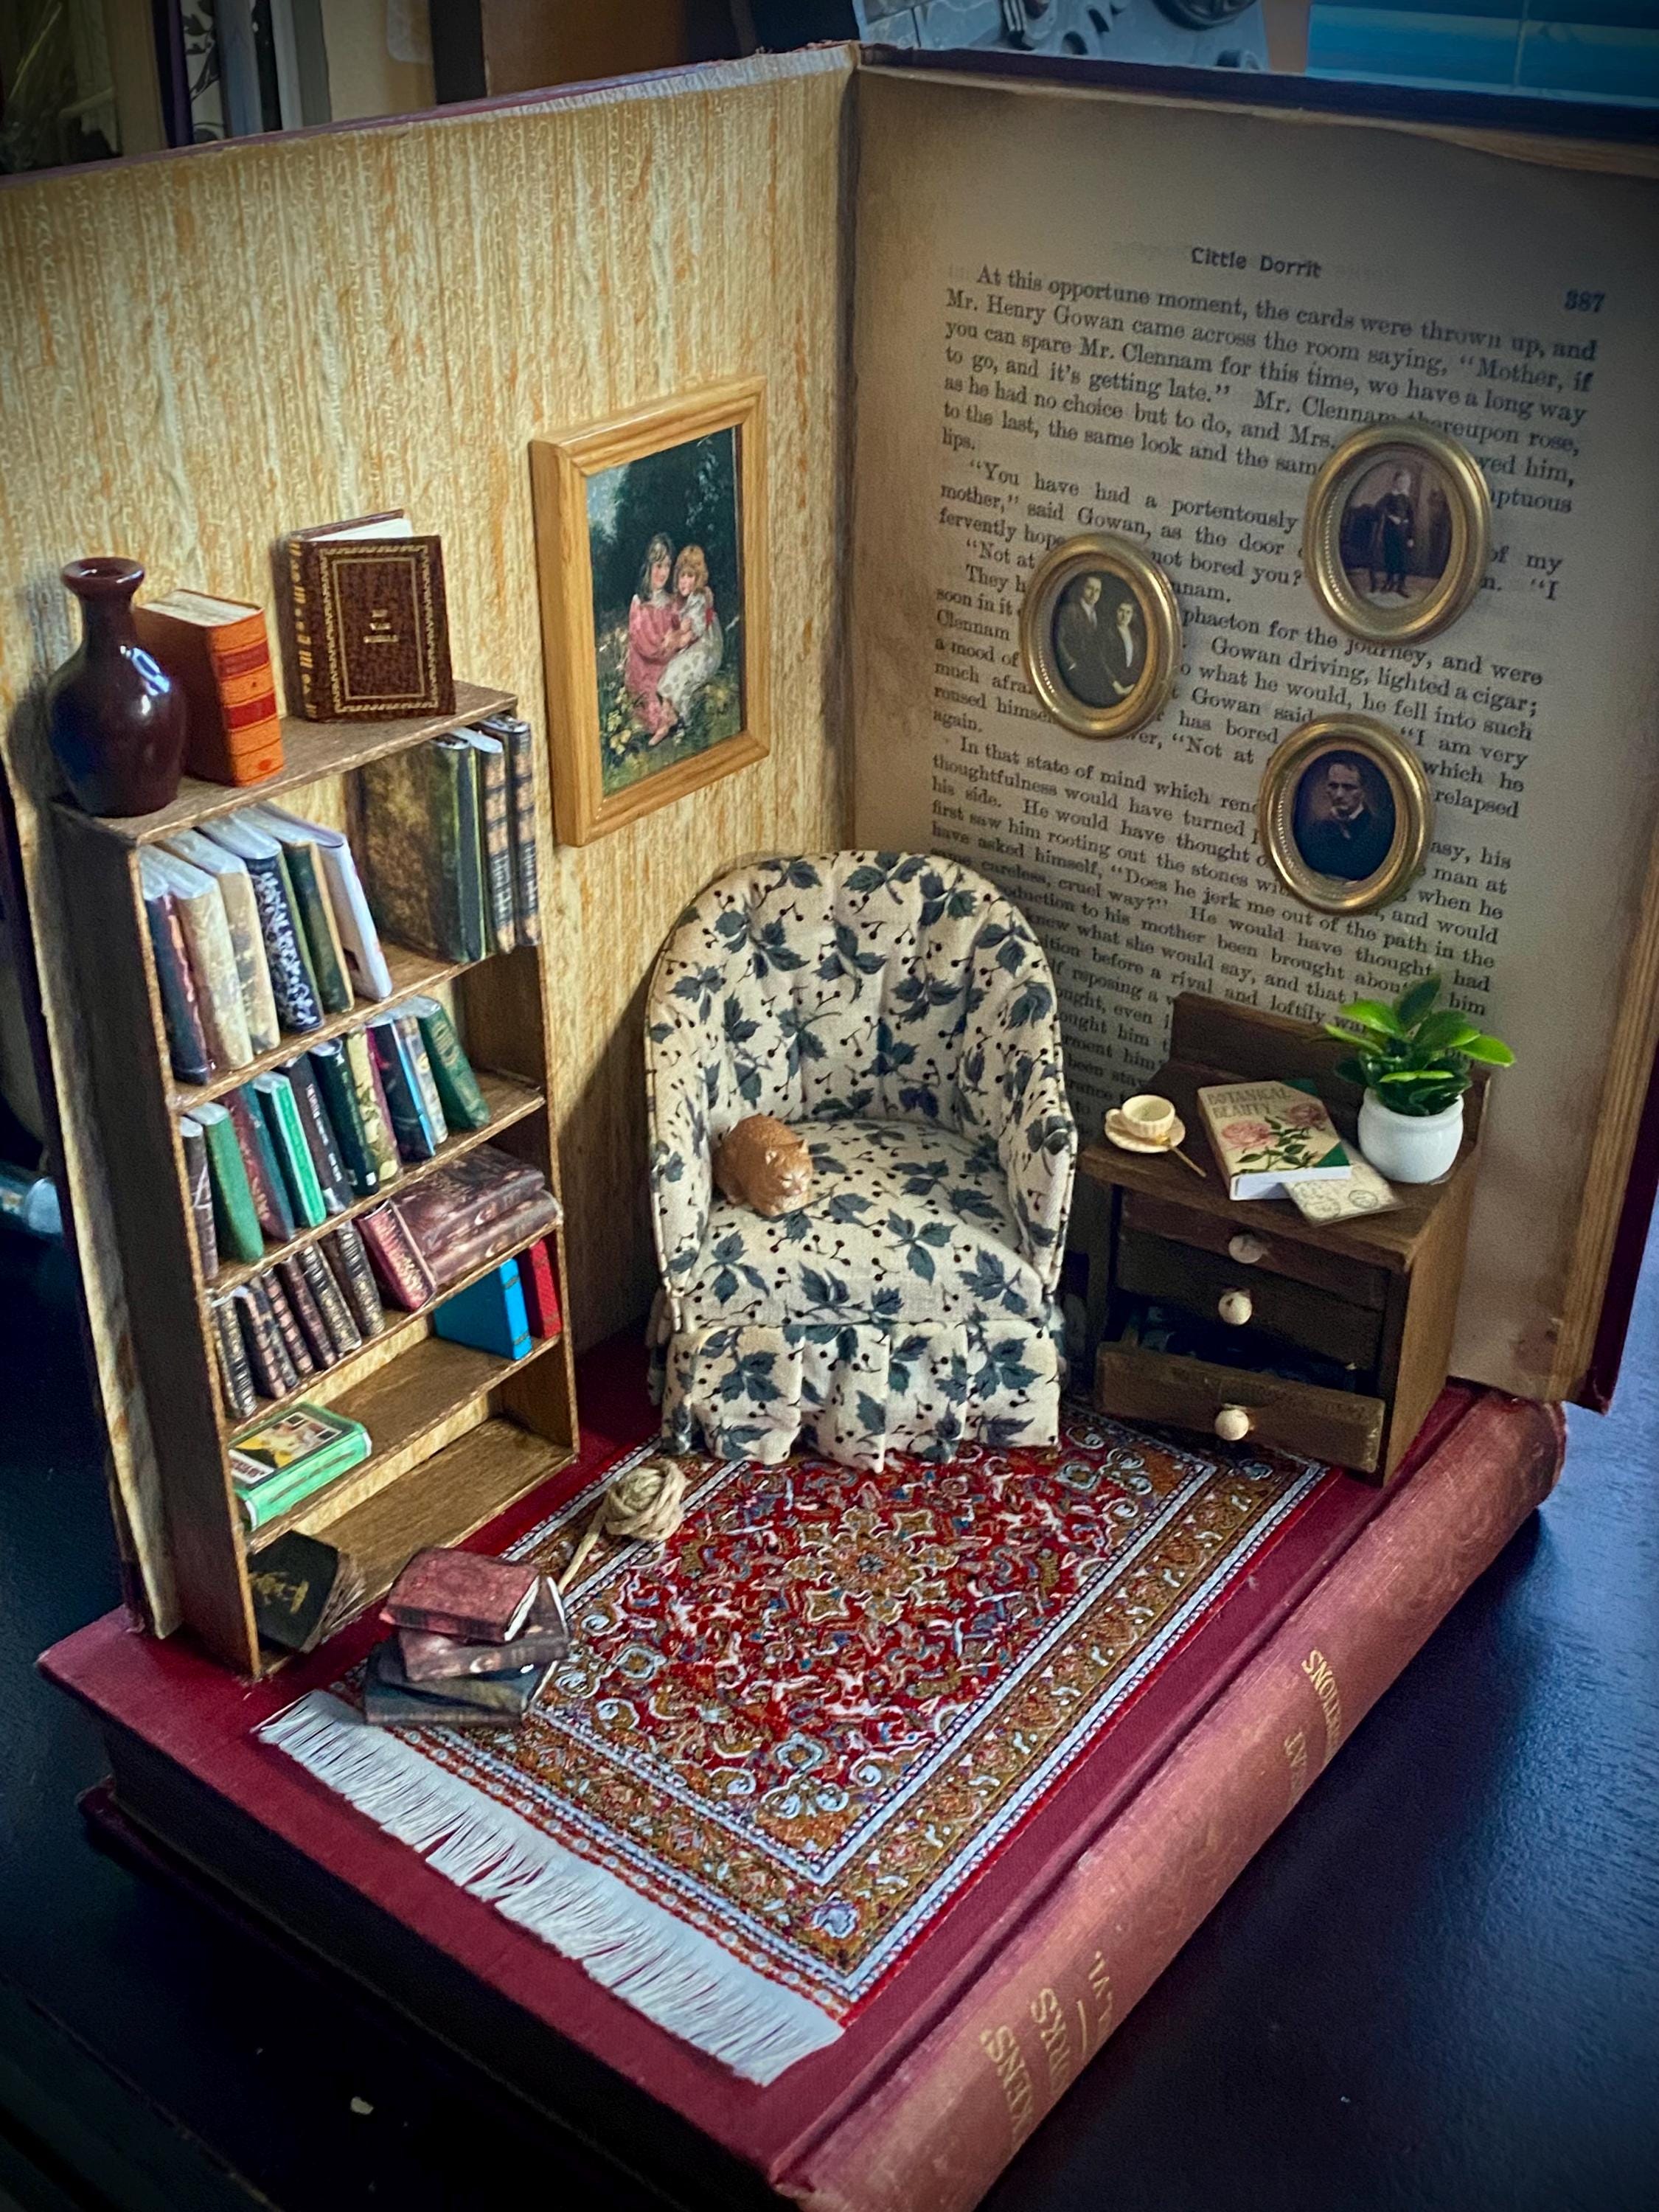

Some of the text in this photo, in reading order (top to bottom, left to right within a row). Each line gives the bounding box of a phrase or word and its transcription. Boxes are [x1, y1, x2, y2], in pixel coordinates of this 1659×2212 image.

[976, 265, 1598, 361] At this opportune moment, the cards were thrown up, and
[1260, 254, 1322, 278] Dorrit
[1564, 288, 1606, 313] 387
[945, 321, 1587, 428] you can spare Mr. Clennam for this time, we have long way
[946, 288, 978, 311] Mr.
[987, 294, 1046, 326] Henry
[1053, 305, 1124, 332] Gowan
[1132, 320, 1185, 339] came
[1192, 328, 1256, 347] across
[1264, 330, 1298, 353] the
[1306, 341, 1360, 361] room
[1368, 348, 1447, 377] saying,
[1573, 371, 1594, 392] if
[942, 426, 975, 452] lips.
[944, 401, 1269, 469] to the last, the same look and the
[945, 378, 963, 393] as
[968, 375, 990, 397] he
[995, 380, 1027, 405] had
[1034, 394, 1057, 409] no
[1062, 394, 1123, 419] choice
[1135, 402, 1167, 425] but
[1175, 409, 1194, 429] to
[1201, 412, 1231, 438] do,
[1241, 421, 1280, 442] and
[1524, 456, 1574, 488] him,
[946, 346, 963, 364] to
[972, 354, 998, 375] go,
[1006, 358, 1038, 378] and
[1049, 361, 1081, 384] it's
[1088, 372, 1162, 400] getting
[1253, 389, 1290, 414] Mr.
[1528, 432, 1579, 457] rose,
[939, 507, 1302, 587] fervently bored you?
[1016, 553, 1035, 569] at
[1027, 501, 1064, 521] said
[1077, 507, 1152, 540] Gowan,
[1160, 526, 1182, 540] as
[1195, 526, 1227, 547] the
[1239, 532, 1285, 555] door
[1034, 472, 1079, 496] have
[1095, 481, 1130, 505] had
[1171, 499, 1298, 535] portentously
[1526, 554, 1563, 577] my
[965, 563, 1543, 686] They for the and were
[977, 593, 1537, 718] in it Gowan driving, lighted cigar;
[1191, 686, 1528, 771] Gowan am very
[1199, 664, 1532, 742] what he would, he fell into such
[960, 736, 1511, 869] In that state of mind which his
[1225, 718, 1525, 793] bored he
[1233, 749, 1254, 765] at
[1433, 788, 1519, 818] relapsed
[932, 799, 1499, 945] first rooting stones would
[933, 754, 1507, 895] thoughtfulness would have turned man at
[1023, 798, 1503, 920] He would have thought when he
[1057, 879, 1490, 993] cruel would have had
[1174, 879, 1495, 969] he jerk me out of the path in the
